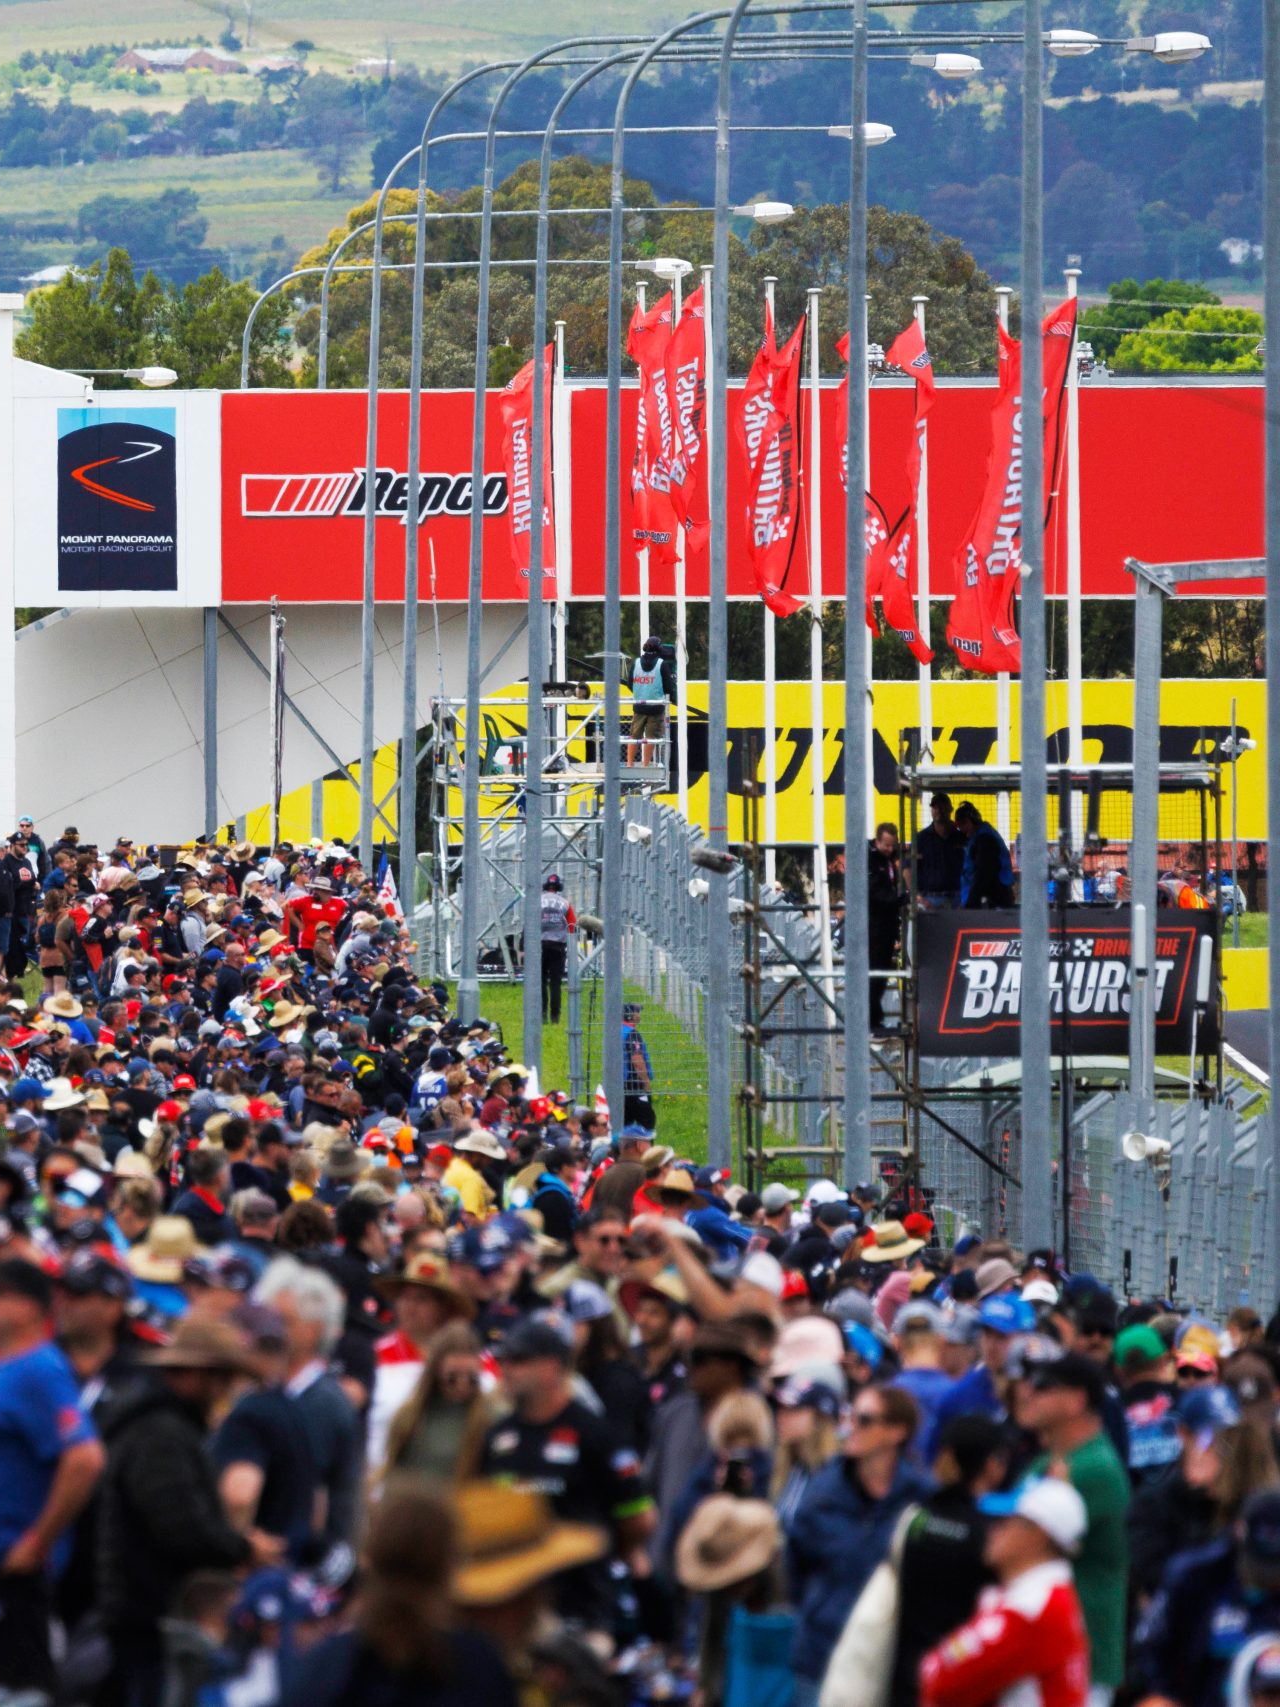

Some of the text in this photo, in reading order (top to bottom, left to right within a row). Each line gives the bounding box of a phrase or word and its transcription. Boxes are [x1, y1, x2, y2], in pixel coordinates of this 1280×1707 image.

[342, 468, 510, 524] Repco
[61, 535, 173, 543] MOUNT PANORAMA
[61, 545, 173, 553] MOTOR RACING CIRCUIT
[1156, 937, 1180, 956] THE
[962, 960, 1174, 1018] BAHURT
